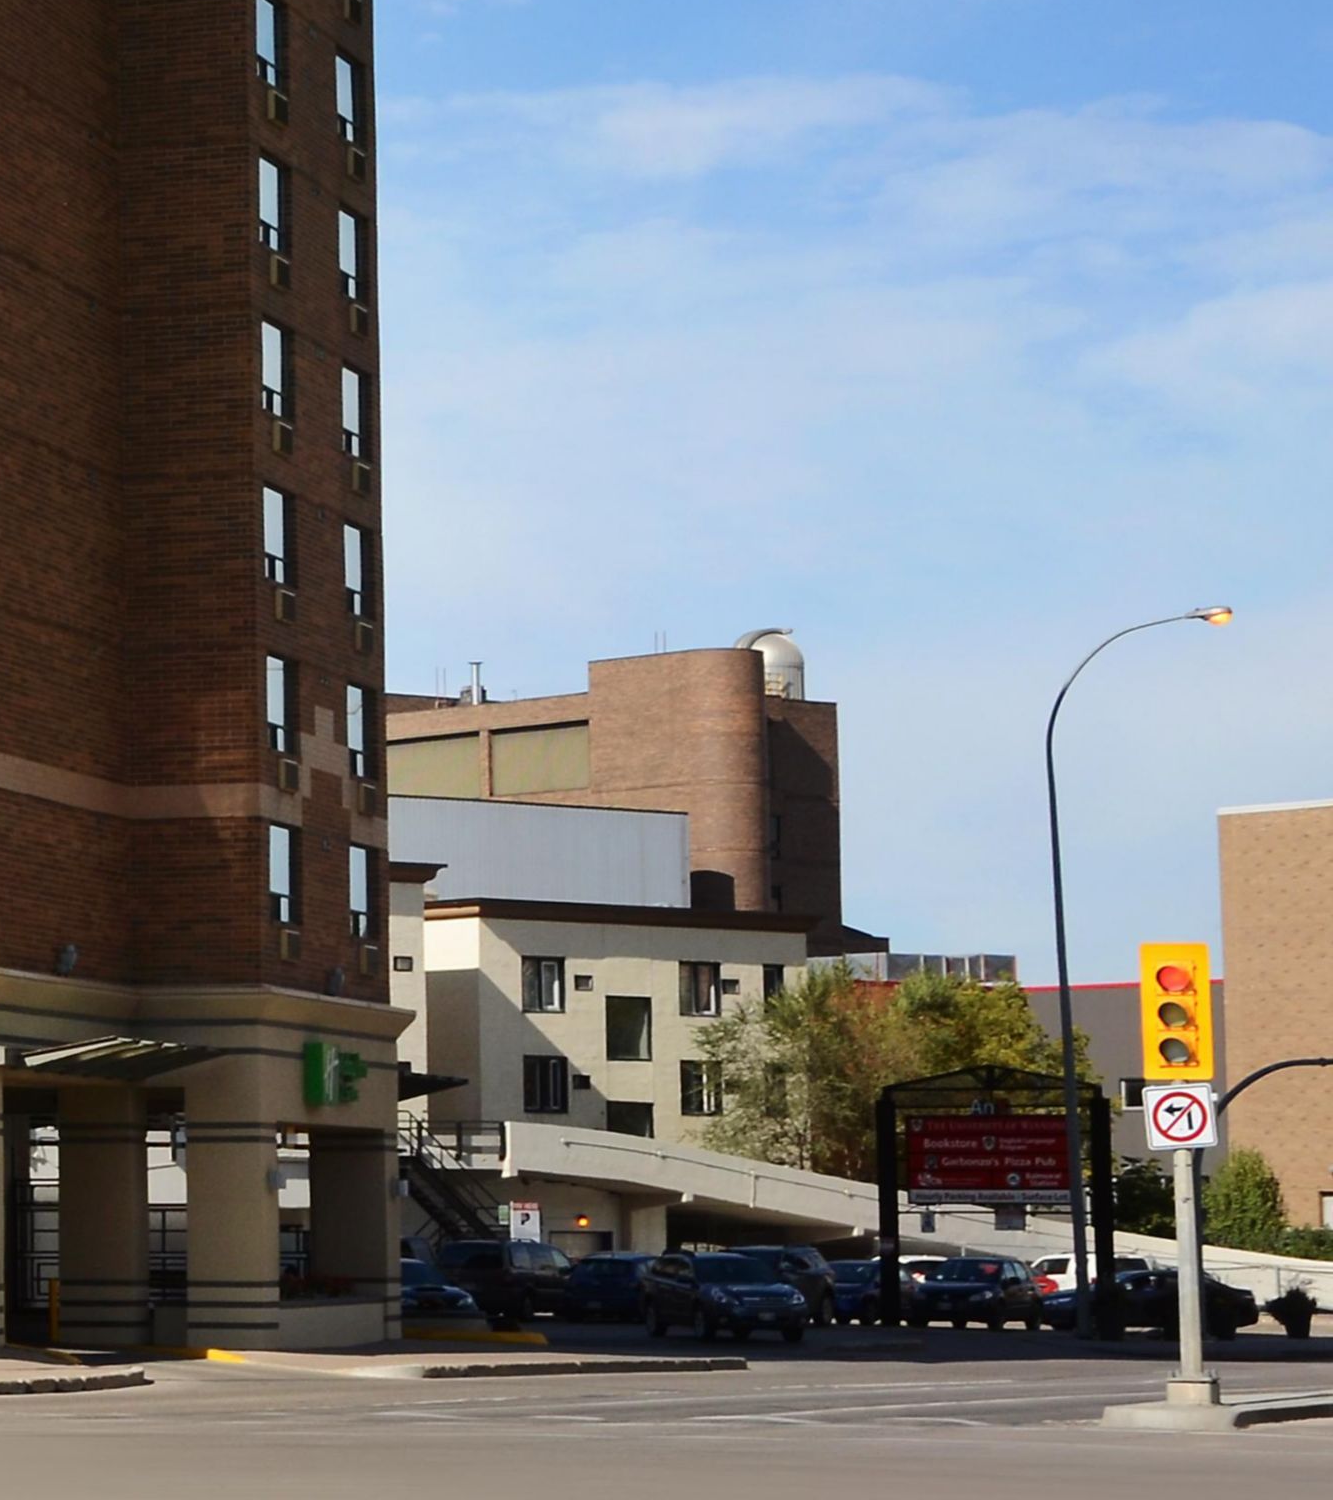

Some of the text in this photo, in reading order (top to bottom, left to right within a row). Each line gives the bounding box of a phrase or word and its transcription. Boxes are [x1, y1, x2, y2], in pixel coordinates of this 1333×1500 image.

[922, 1137, 978, 1149] Bookstore
[941, 1156, 1056, 1167] Garbonzo's Pizza Pub
